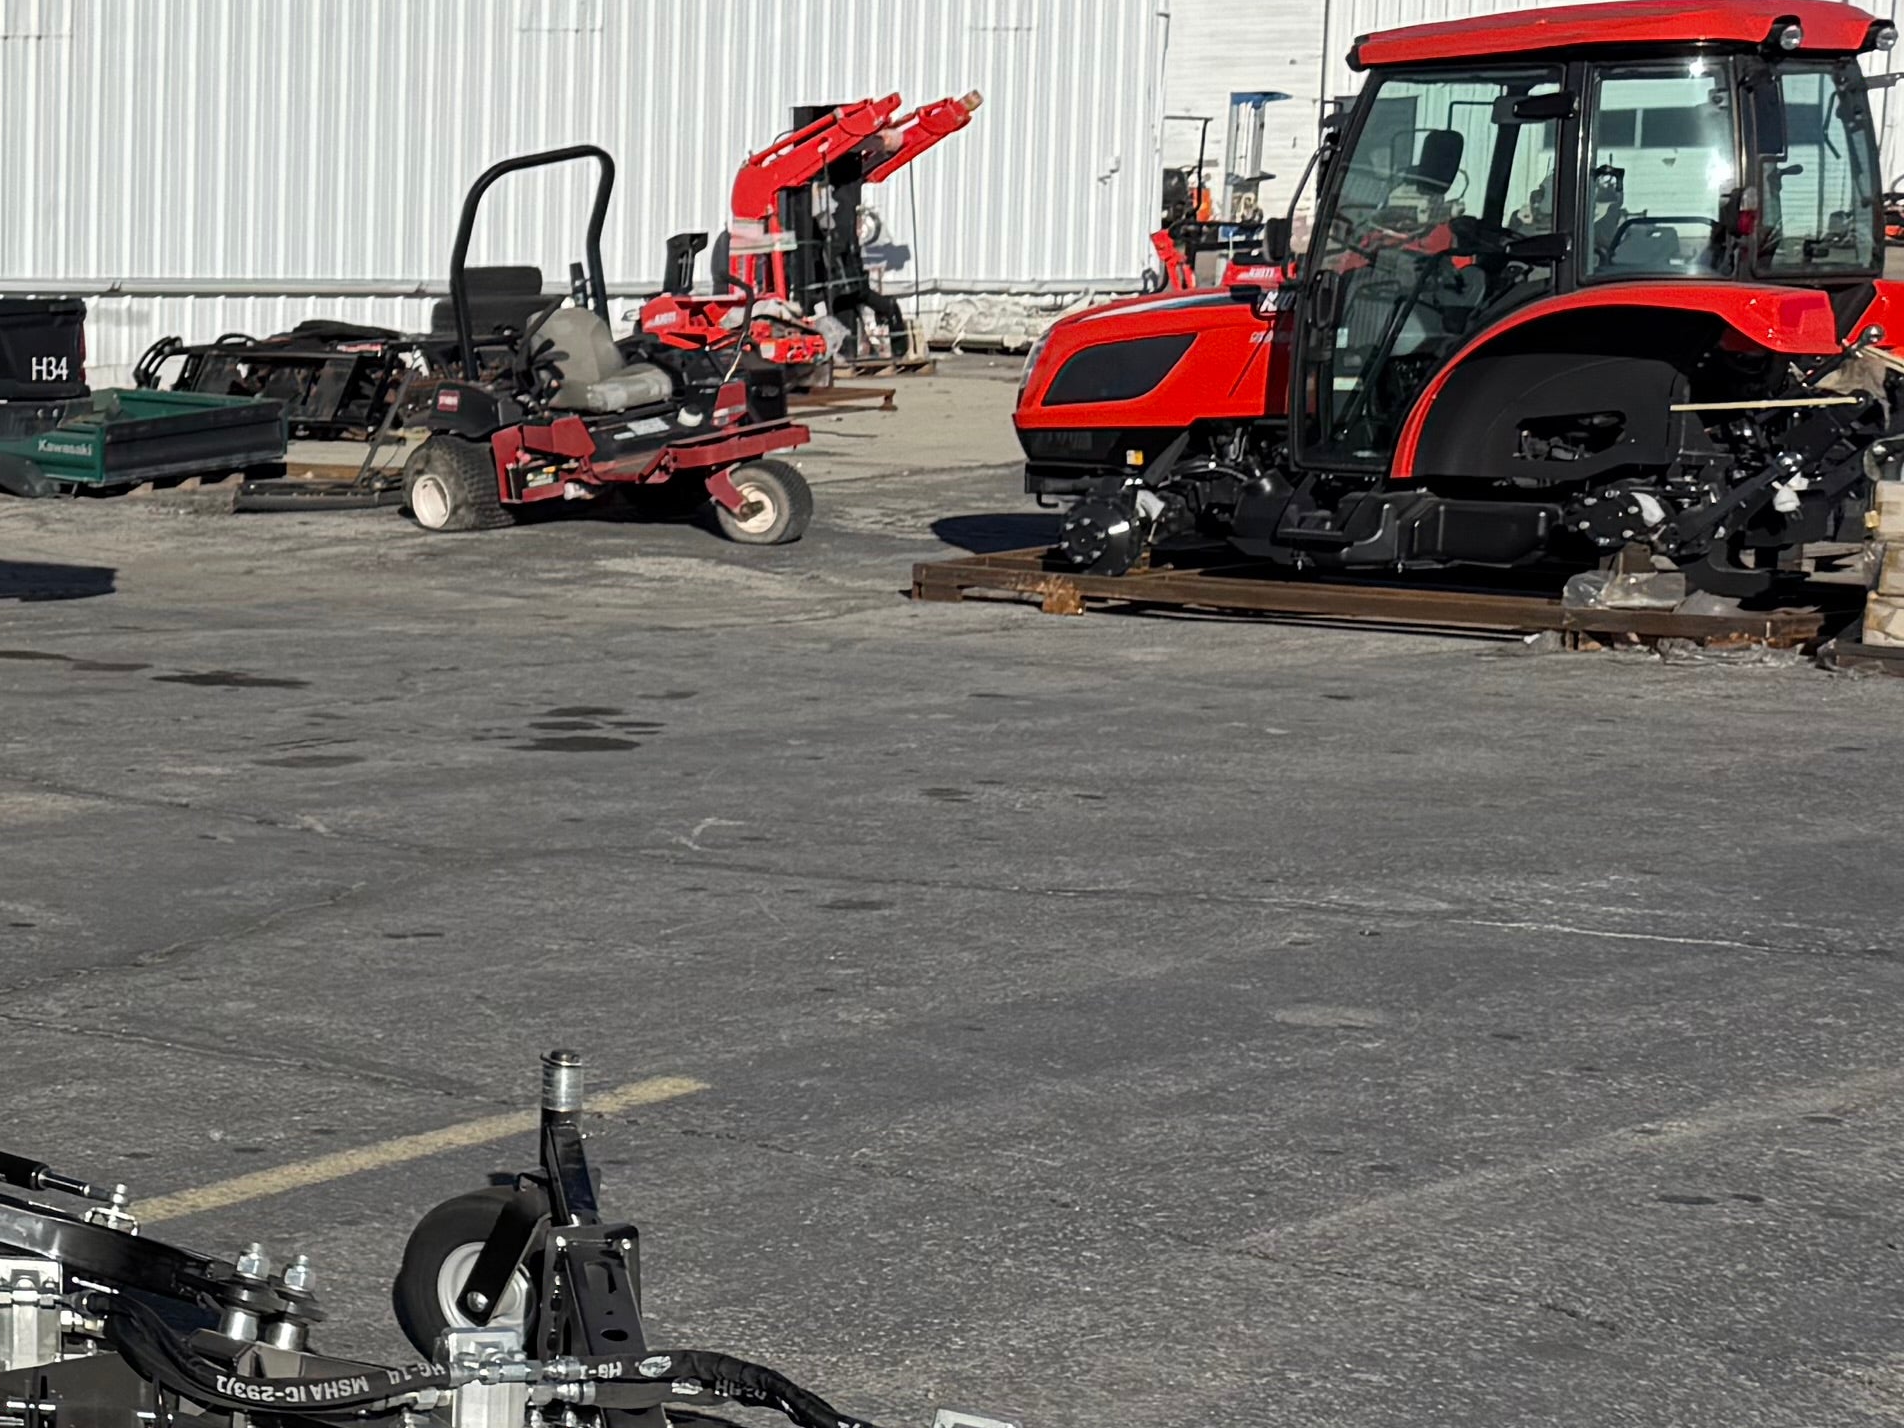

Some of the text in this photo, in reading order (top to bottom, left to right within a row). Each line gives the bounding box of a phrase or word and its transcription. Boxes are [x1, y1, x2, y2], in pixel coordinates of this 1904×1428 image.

[31, 356, 69, 381] H34
[38, 439, 92, 457] Kawasaki
[312, 1375, 369, 1394] MSHA
